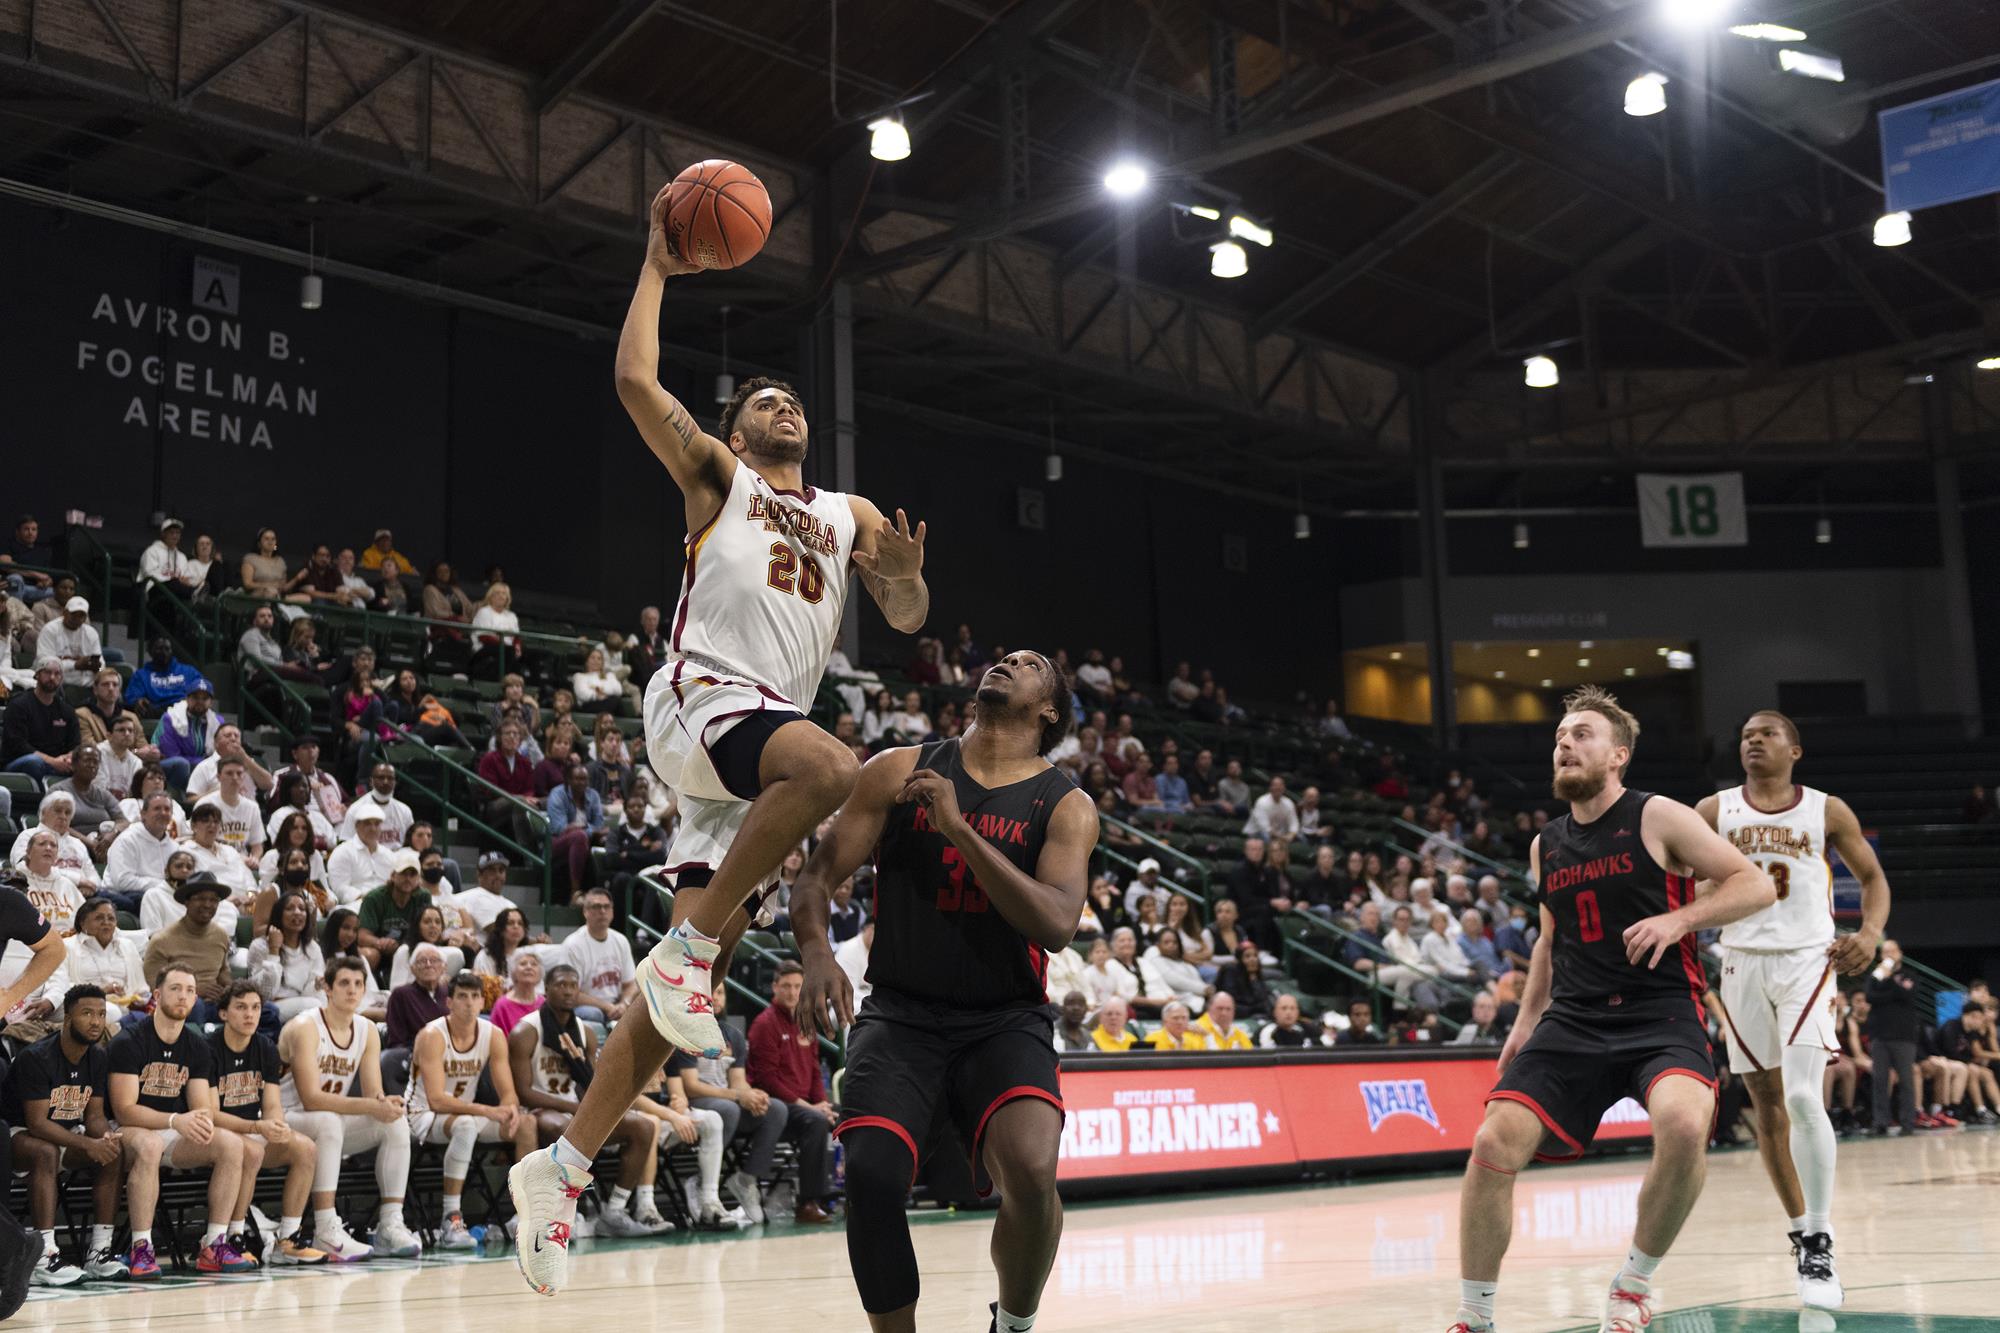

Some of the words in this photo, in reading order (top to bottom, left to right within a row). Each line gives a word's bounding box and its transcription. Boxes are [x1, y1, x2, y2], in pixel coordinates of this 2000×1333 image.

[204, 277, 227, 307] A
[91, 292, 242, 350] AVRON
[268, 330, 305, 364] B.
[77, 341, 318, 416] FOGELMAN
[123, 396, 273, 450] ARENA
[747, 493, 839, 556] LOYOLA
[1666, 483, 1721, 537] 18
[767, 540, 826, 604] 20
[1575, 889, 1604, 943] 0
[1113, 1090, 1152, 1106] BATTLE
[1153, 1089, 1173, 1104] FOR
[1174, 1088, 1196, 1103] THE
[1359, 1079, 1440, 1133] NAIA
[1059, 1108, 1123, 1159] RED
[1127, 1102, 1262, 1156] BANNER
